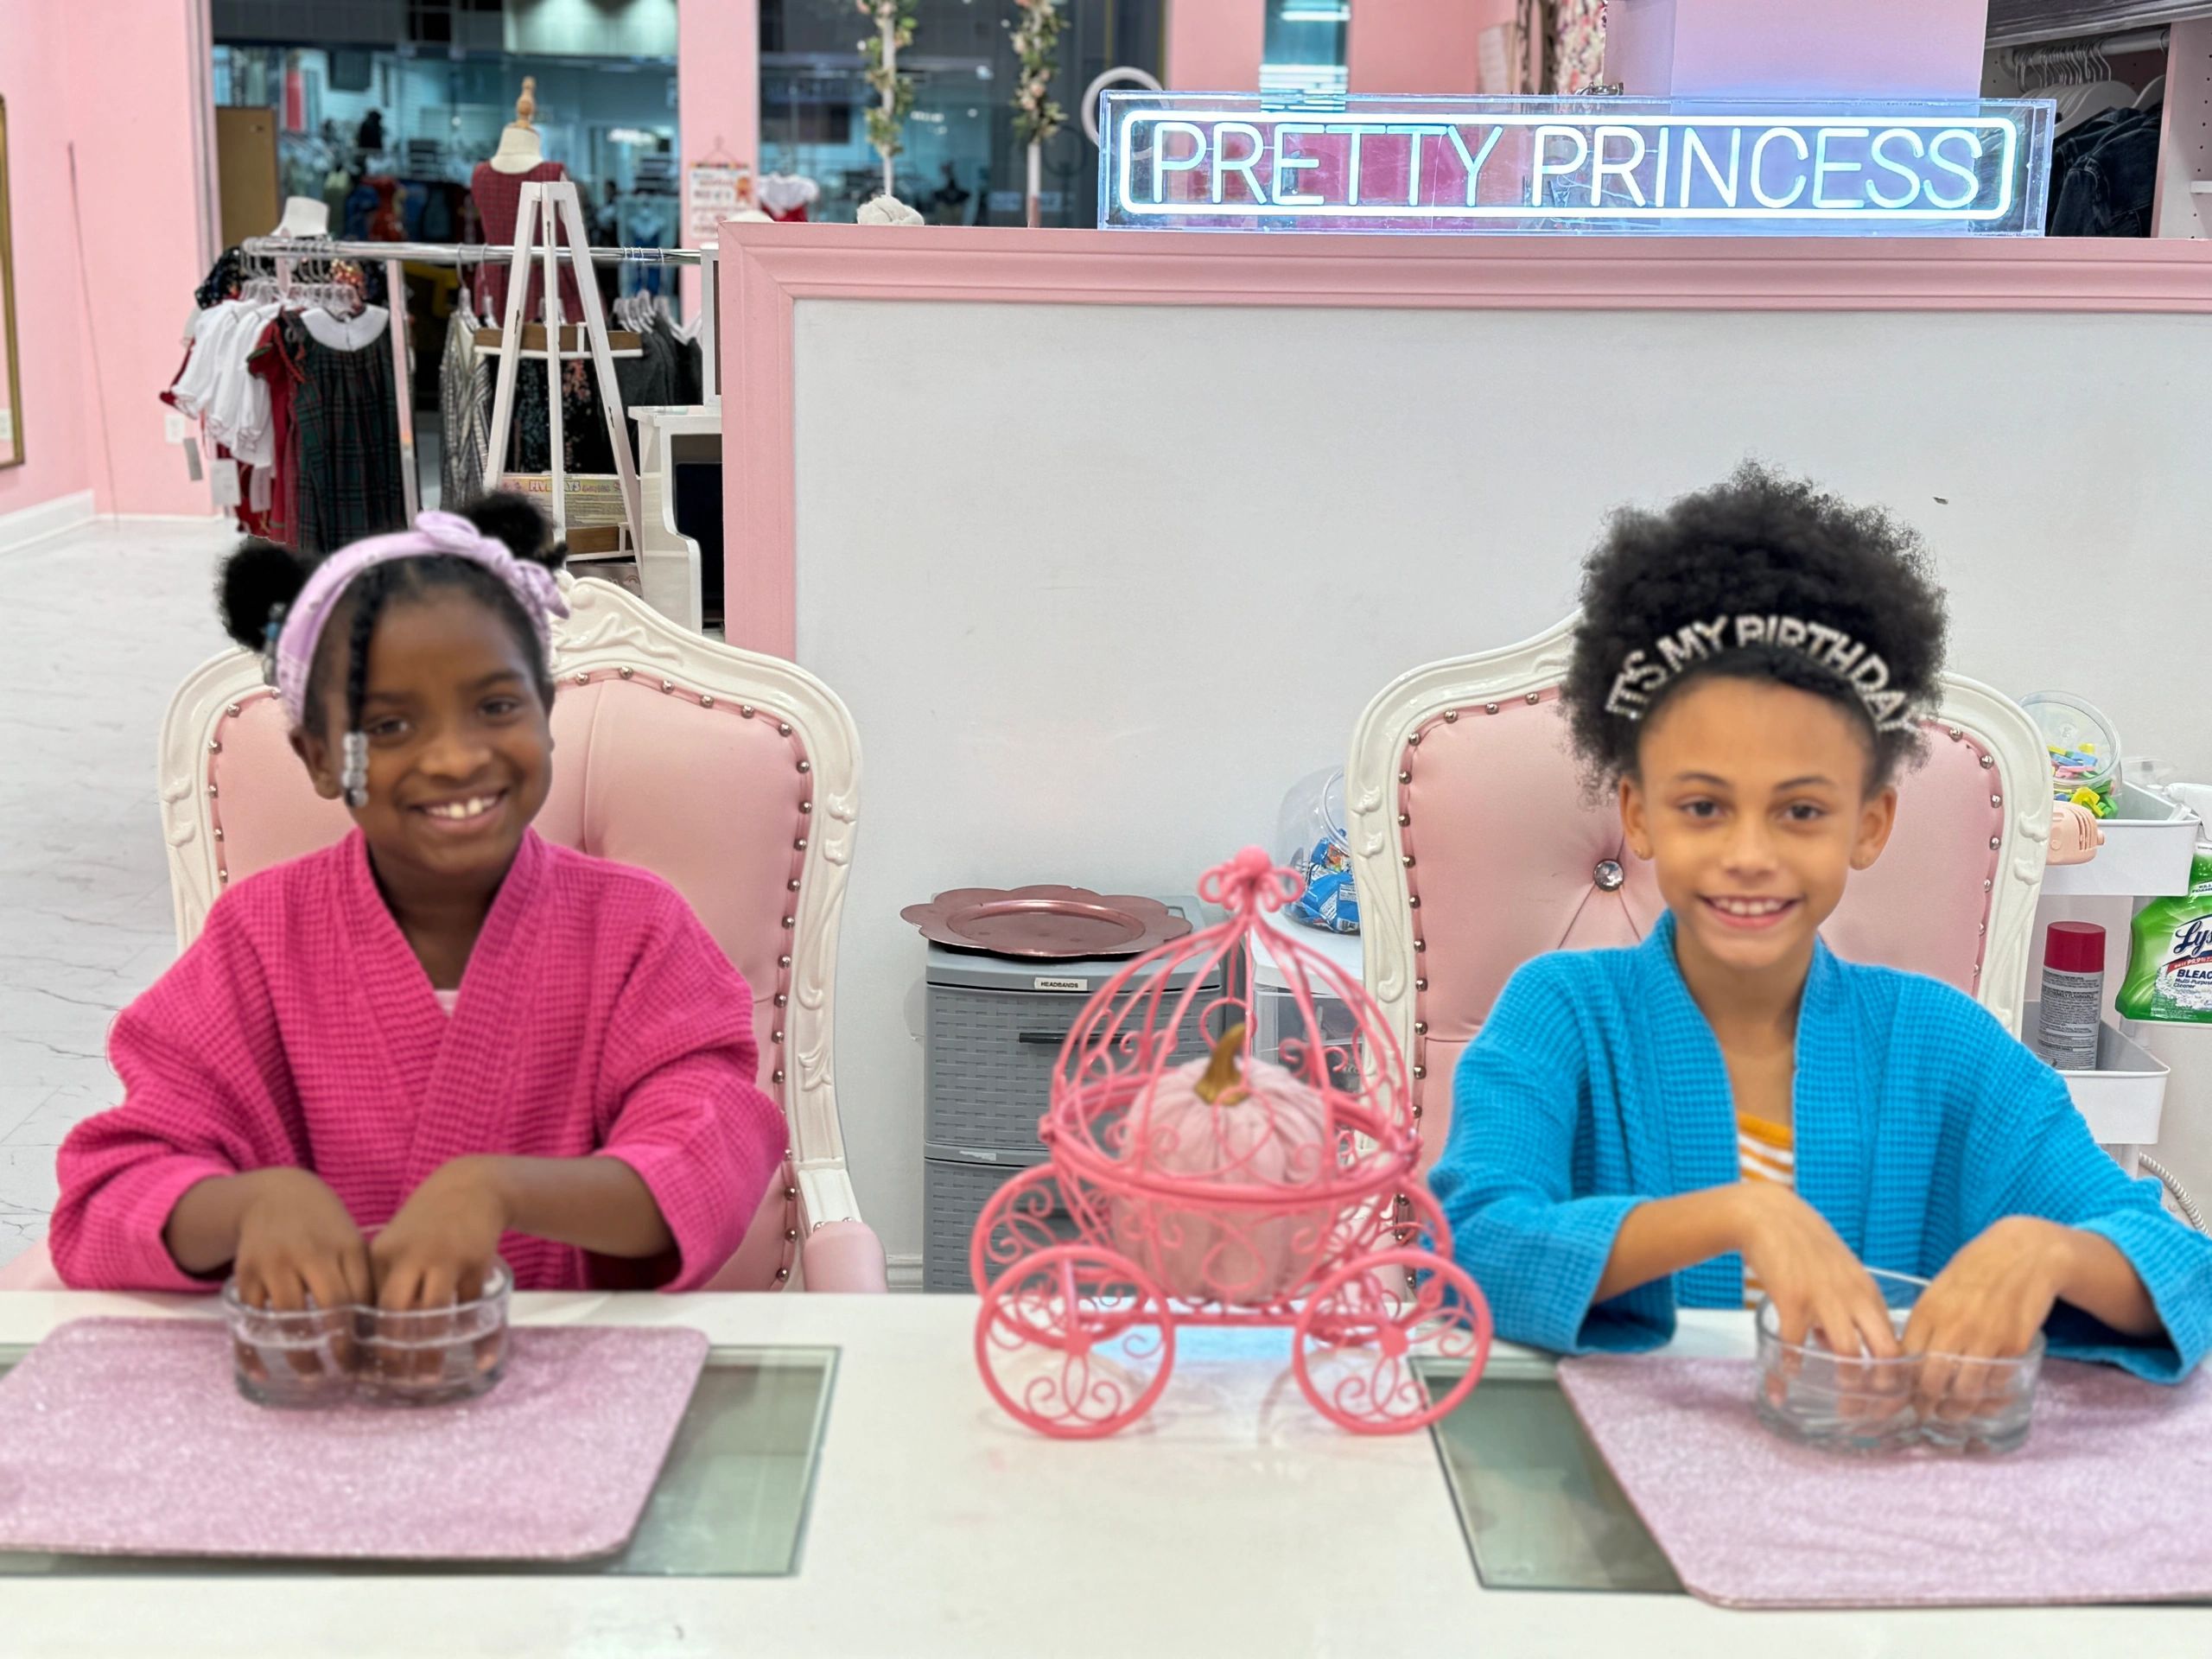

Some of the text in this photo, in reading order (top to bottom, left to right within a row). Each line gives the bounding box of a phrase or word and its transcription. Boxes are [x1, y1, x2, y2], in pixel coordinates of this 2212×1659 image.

[1152, 123, 1983, 210] PRETTY PRINCESS
[529, 480, 553, 493] FIV
[1656, 614, 1728, 673] MY
[1734, 613, 1917, 734] BIRTHDAY
[2177, 969, 2212, 980] BLEAC
